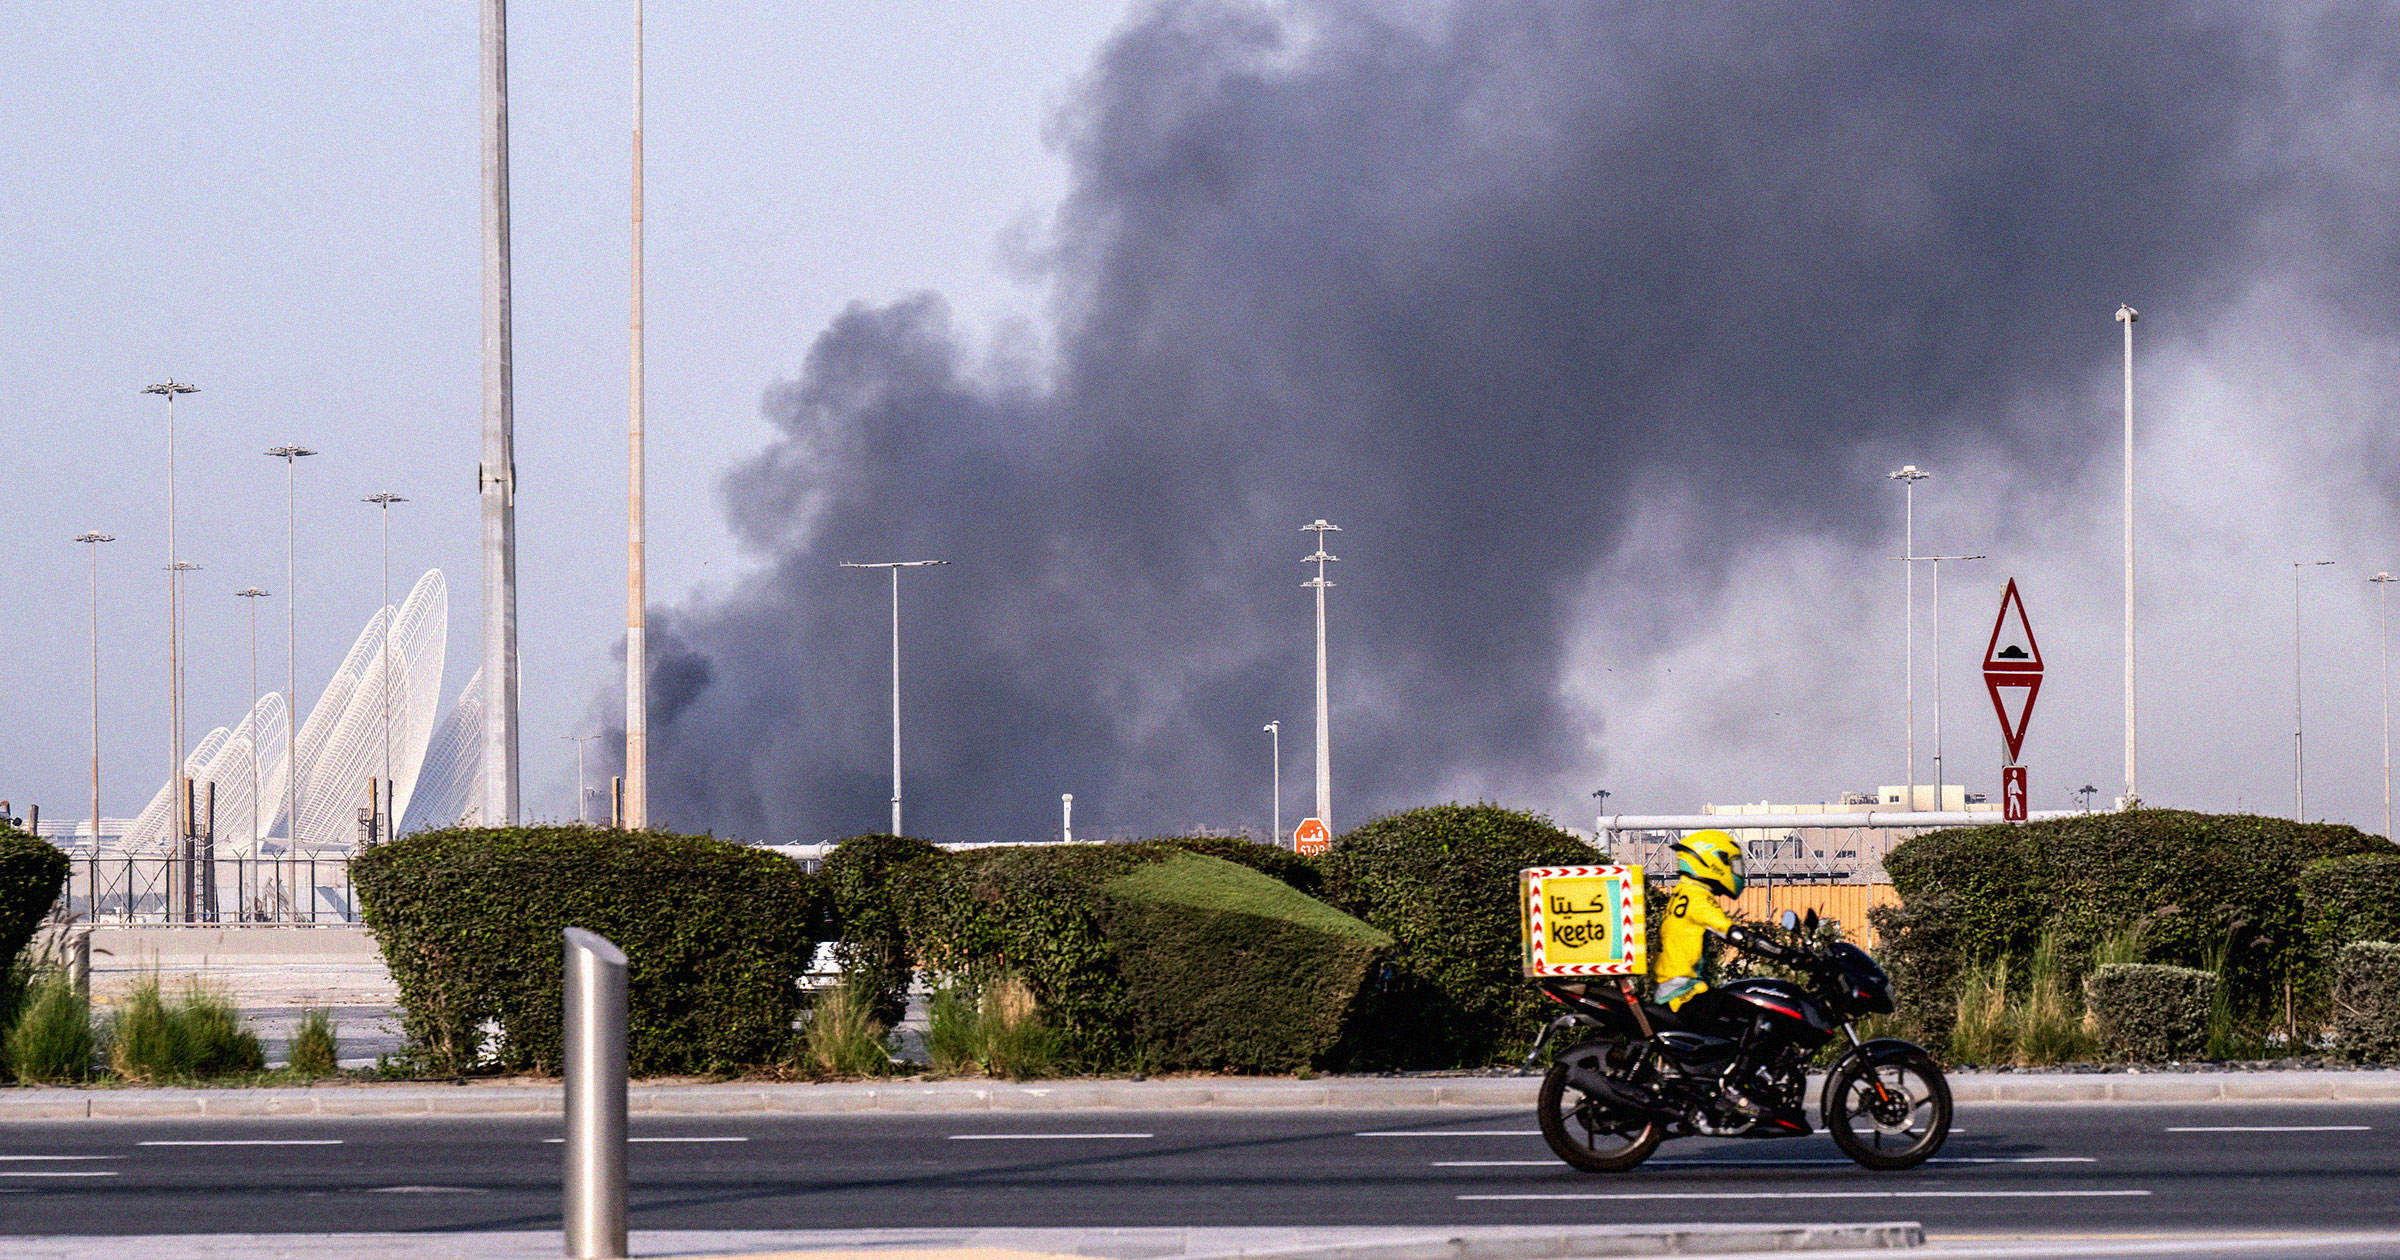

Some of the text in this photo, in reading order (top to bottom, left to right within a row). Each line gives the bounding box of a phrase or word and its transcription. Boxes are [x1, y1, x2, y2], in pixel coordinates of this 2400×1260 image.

[1301, 826, 1323, 841] قف
[1550, 894, 1604, 919] كيتا
[1552, 920, 1604, 948] keeta
